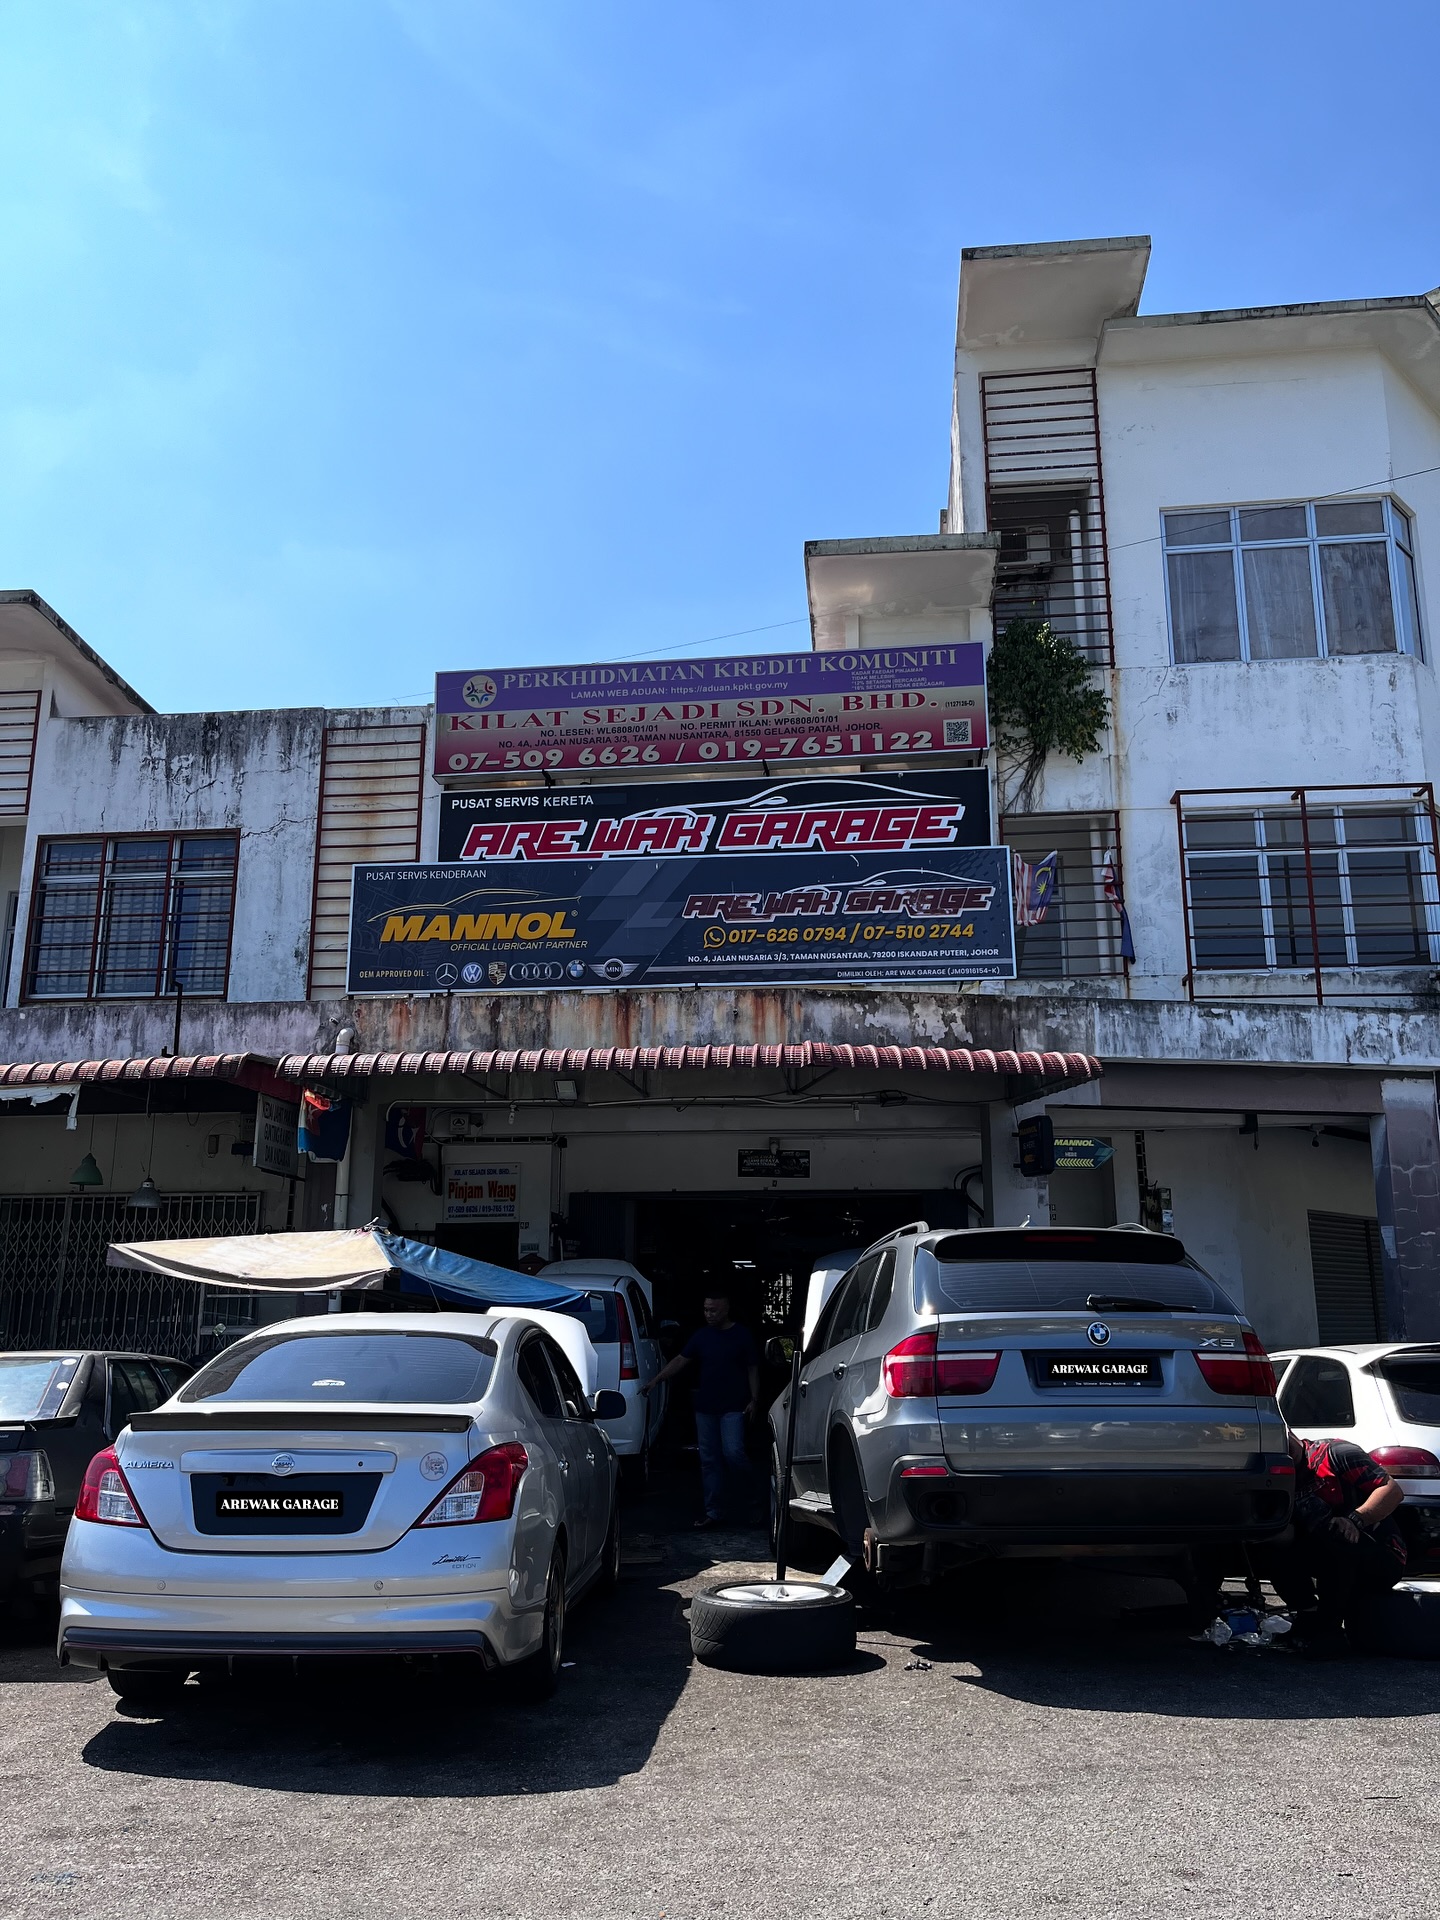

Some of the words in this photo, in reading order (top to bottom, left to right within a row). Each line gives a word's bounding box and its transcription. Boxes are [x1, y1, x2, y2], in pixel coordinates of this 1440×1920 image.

[503, 664, 704, 689] PERKHIDMATAN
[714, 658, 811, 679] KREDIT
[820, 649, 957, 672] KOMUNITI
[571, 690, 604, 700] LAMAN
[607, 689, 628, 698] WEB
[631, 687, 668, 697] ADUAN:
[670, 681, 788, 696] https://aduan.kpkt.gov.my
[448, 710, 569, 731] KILAT
[582, 701, 721, 726] SEJADI
[737, 698, 825, 719] SDN.
[840, 692, 939, 713] BHD.
[540, 729, 557, 737] NO.
[560, 727, 594, 737] LESEN:
[597, 724, 658, 735] WL6808/01/01
[680, 722, 698, 731] NO.
[700, 720, 736, 730] PERMIT
[738, 718, 771, 728] IKLAN:
[774, 715, 839, 726] WP6808/01/01
[498, 740, 515, 748] NO.
[517, 739, 532, 749] 4A,
[535, 738, 567, 747] JALAN
[569, 736, 612, 746] NUSARIA
[614, 734, 631, 745] 3/3,
[633, 732, 667, 742] TAMAN
[669, 729, 732, 741] NUSANTARA,
[734, 727, 762, 737] 81550
[764, 725, 805, 736] GELANG
[808, 723, 842, 735] PATAH,
[845, 721, 883, 732] JOHOR.
[448, 749, 564, 772] 07-509
[578, 745, 661, 765] 6626
[675, 742, 686, 762] /
[698, 731, 933, 760] 019-7651122
[451, 798, 492, 810] PUSAT
[494, 796, 540, 808] SERVIS
[543, 795, 594, 807] KERETA
[459, 819, 596, 860] ARE
[587, 814, 717, 854] WAK
[716, 804, 966, 852] GARAGE
[366, 871, 395, 881] PUSAT
[397, 870, 428, 880] SERVIS
[429, 869, 487, 879] KENDERAAN
[682, 893, 767, 924] ARE
[764, 890, 843, 916] WAK
[842, 886, 996, 919] GARAGE
[380, 911, 577, 942] MANNOL
[728, 928, 799, 943] 017-626
[802, 927, 847, 942] 0794
[850, 922, 861, 943] /
[863, 925, 925, 940] 07-510
[929, 923, 974, 939] 2744
[450, 942, 490, 952] OFFICIAL
[492, 941, 544, 951] LUBRICANT
[546, 940, 588, 950] PARTNER
[688, 955, 702, 963] NO.
[703, 955, 711, 963] 4,
[738, 954, 772, 962] NUSARIA
[773, 952, 789, 962] 3/3,
[791, 952, 819, 960] TAMAN
[820, 951, 871, 960] NUSANTARA,
[897, 949, 938, 958] ISKANDAR
[940, 949, 969, 957] PUTERI,
[970, 948, 999, 956] JOHOR
[359, 970, 373, 979] OEM
[374, 969, 412, 978] APPROVED
[413, 969, 425, 978] OIL
[837, 970, 864, 978] DIMILIKI
[899, 968, 916, 976] WAK
[1054, 1139, 1094, 1147] MANNOL
[448, 1182, 483, 1203] Pinjam
[487, 1180, 516, 1203] Wang
[1199, 1337, 1236, 1348] X5
[124, 1460, 174, 1470] ALMERA
